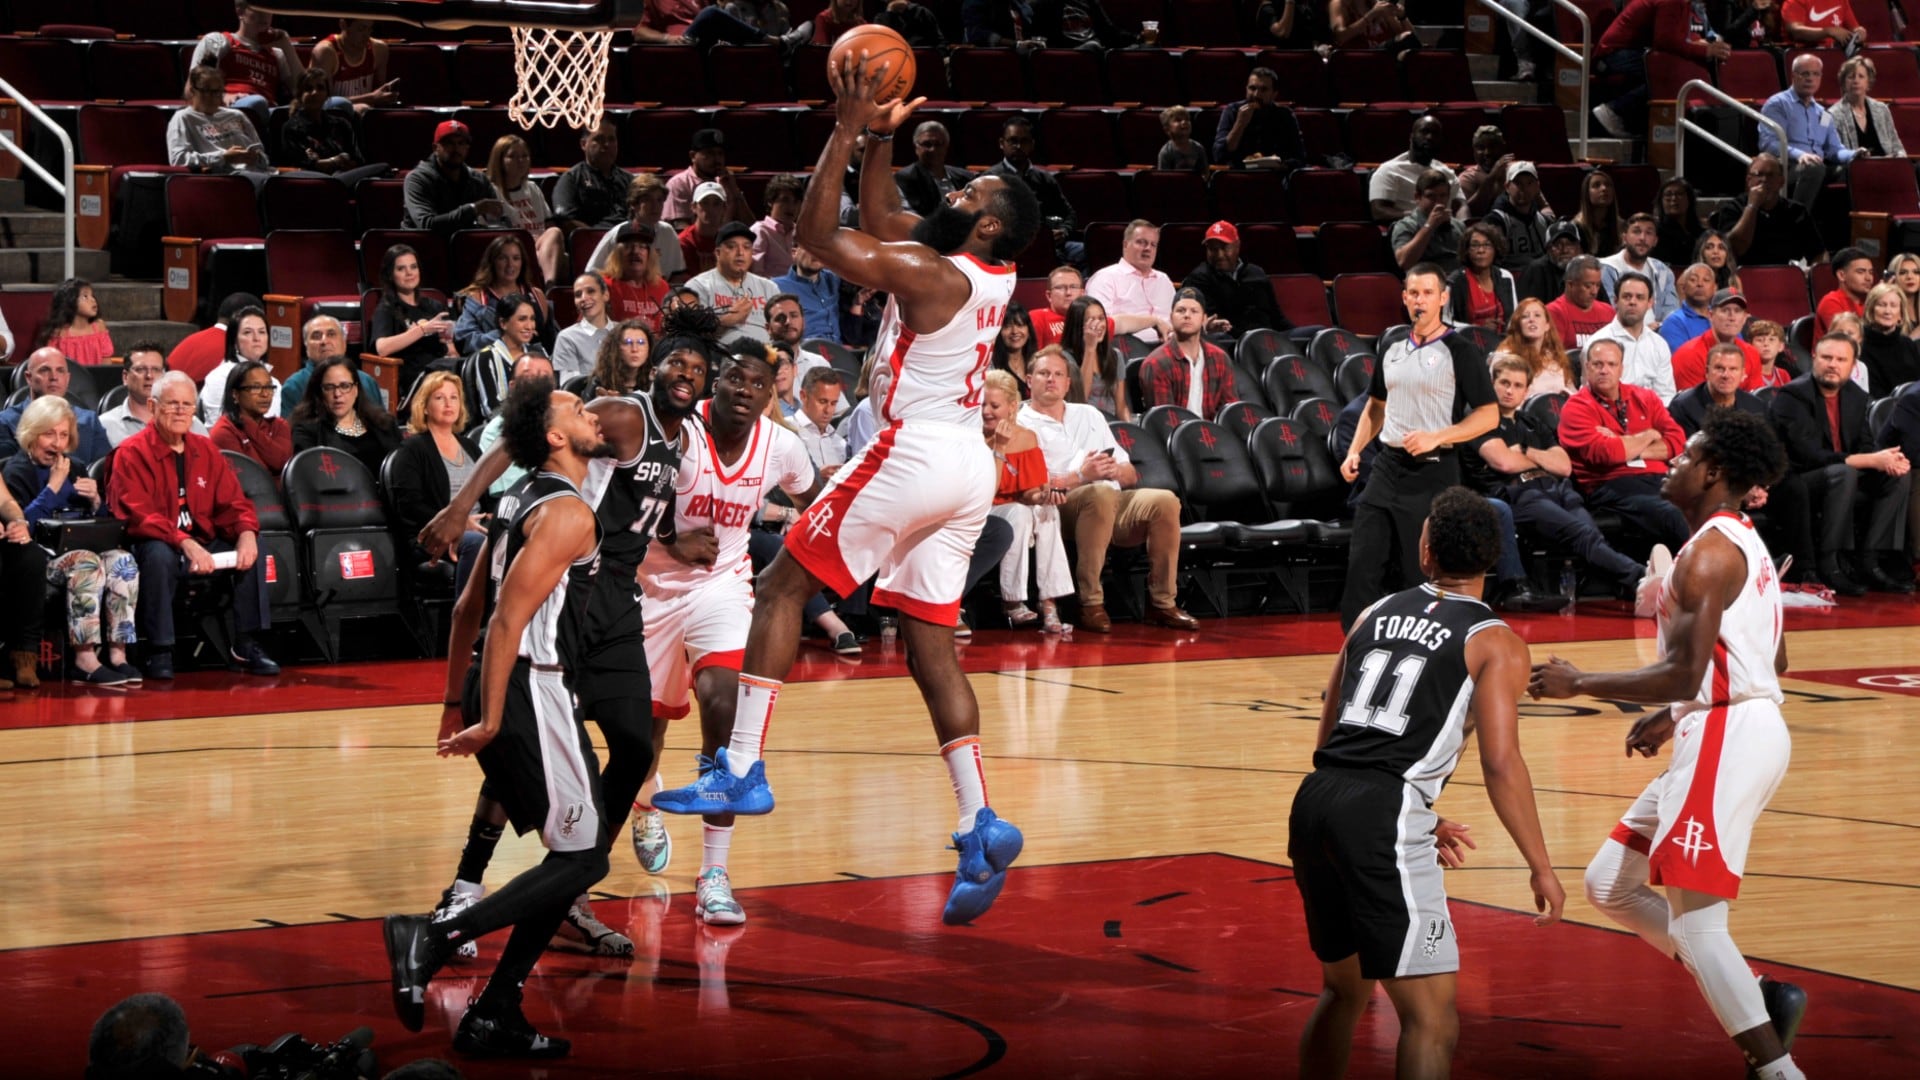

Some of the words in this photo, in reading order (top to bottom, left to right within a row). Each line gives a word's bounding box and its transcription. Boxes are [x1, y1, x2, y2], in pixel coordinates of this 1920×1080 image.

[629, 496, 670, 538] 77
[684, 493, 751, 529] ROKETS
[1374, 614, 1452, 651] FORBES
[1339, 648, 1428, 737] 11
